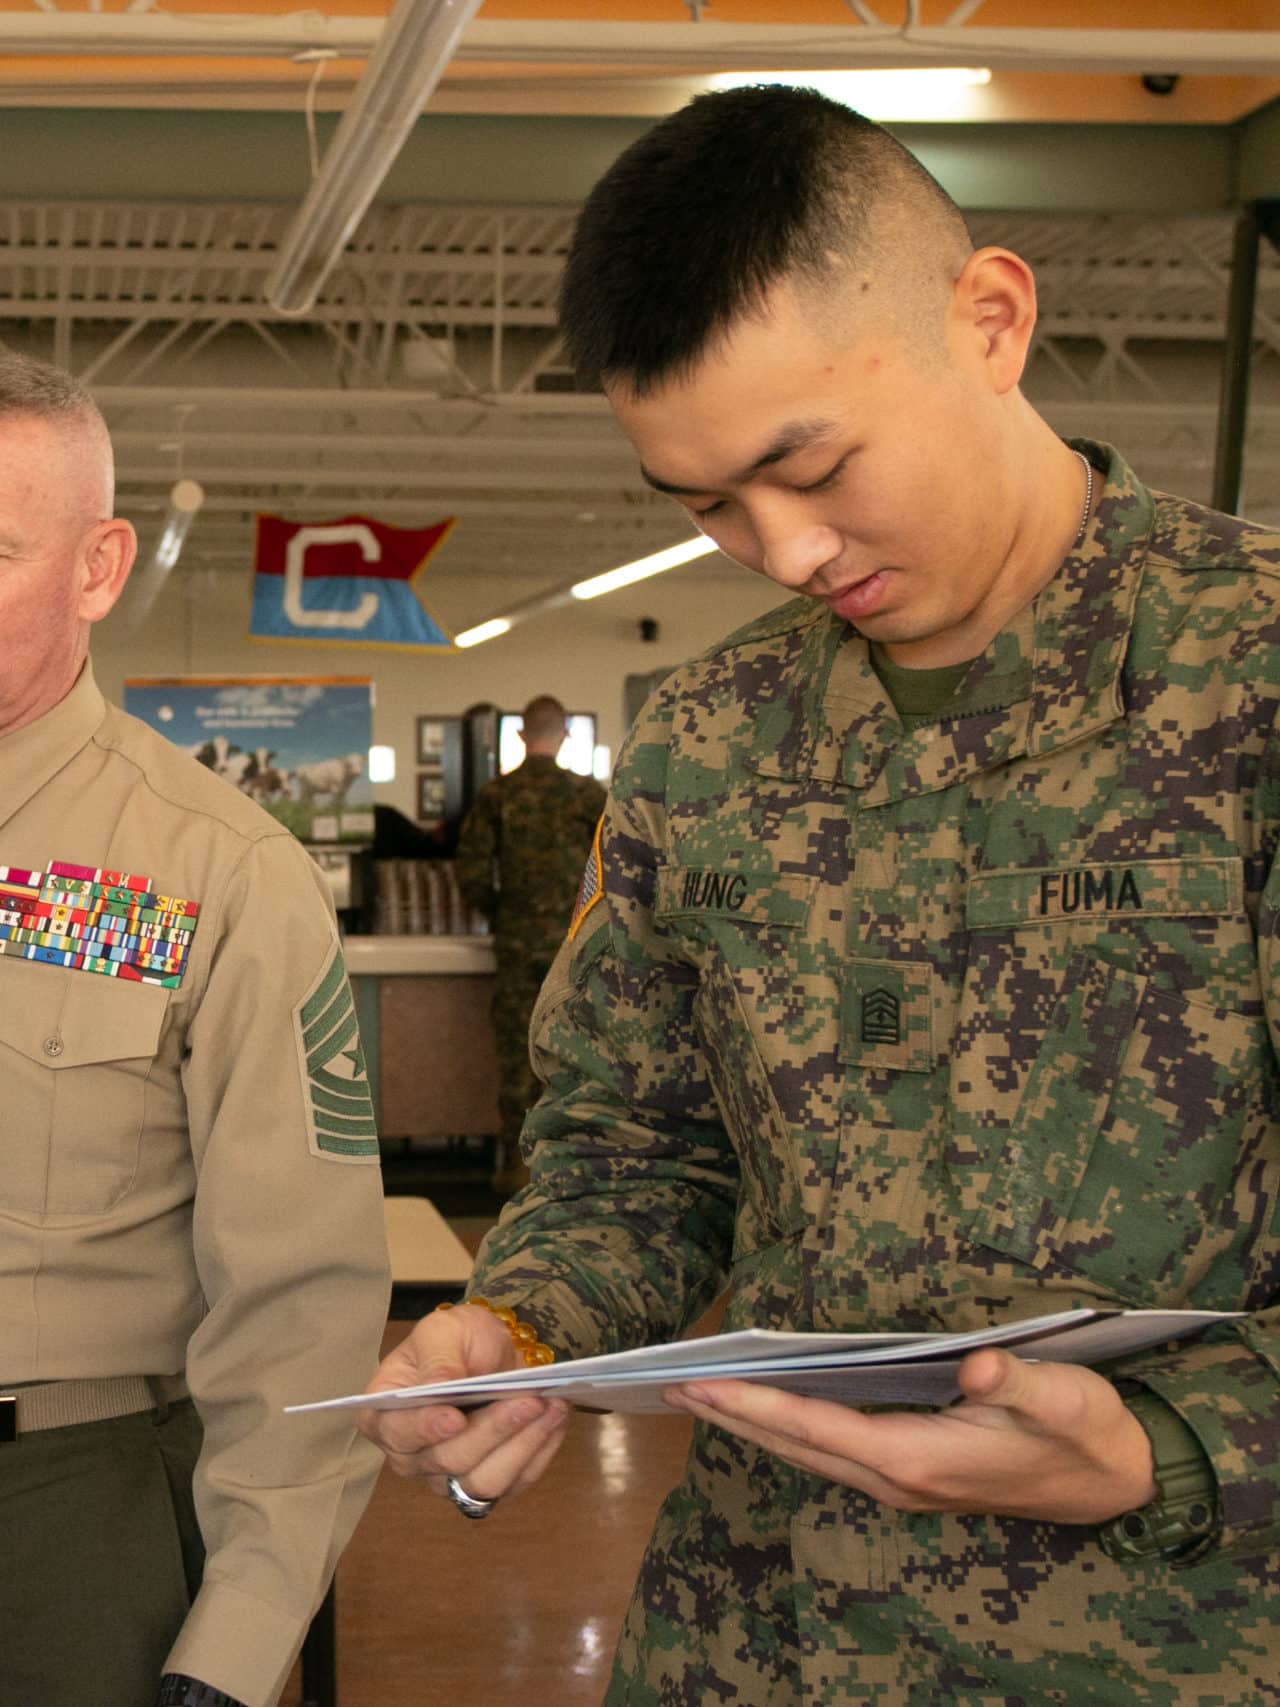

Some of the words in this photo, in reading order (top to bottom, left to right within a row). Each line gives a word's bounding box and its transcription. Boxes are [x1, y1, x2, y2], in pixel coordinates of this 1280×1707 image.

[283, 523, 382, 630] C
[682, 871, 748, 911] HUNG
[1040, 869, 1143, 915] FUMA
